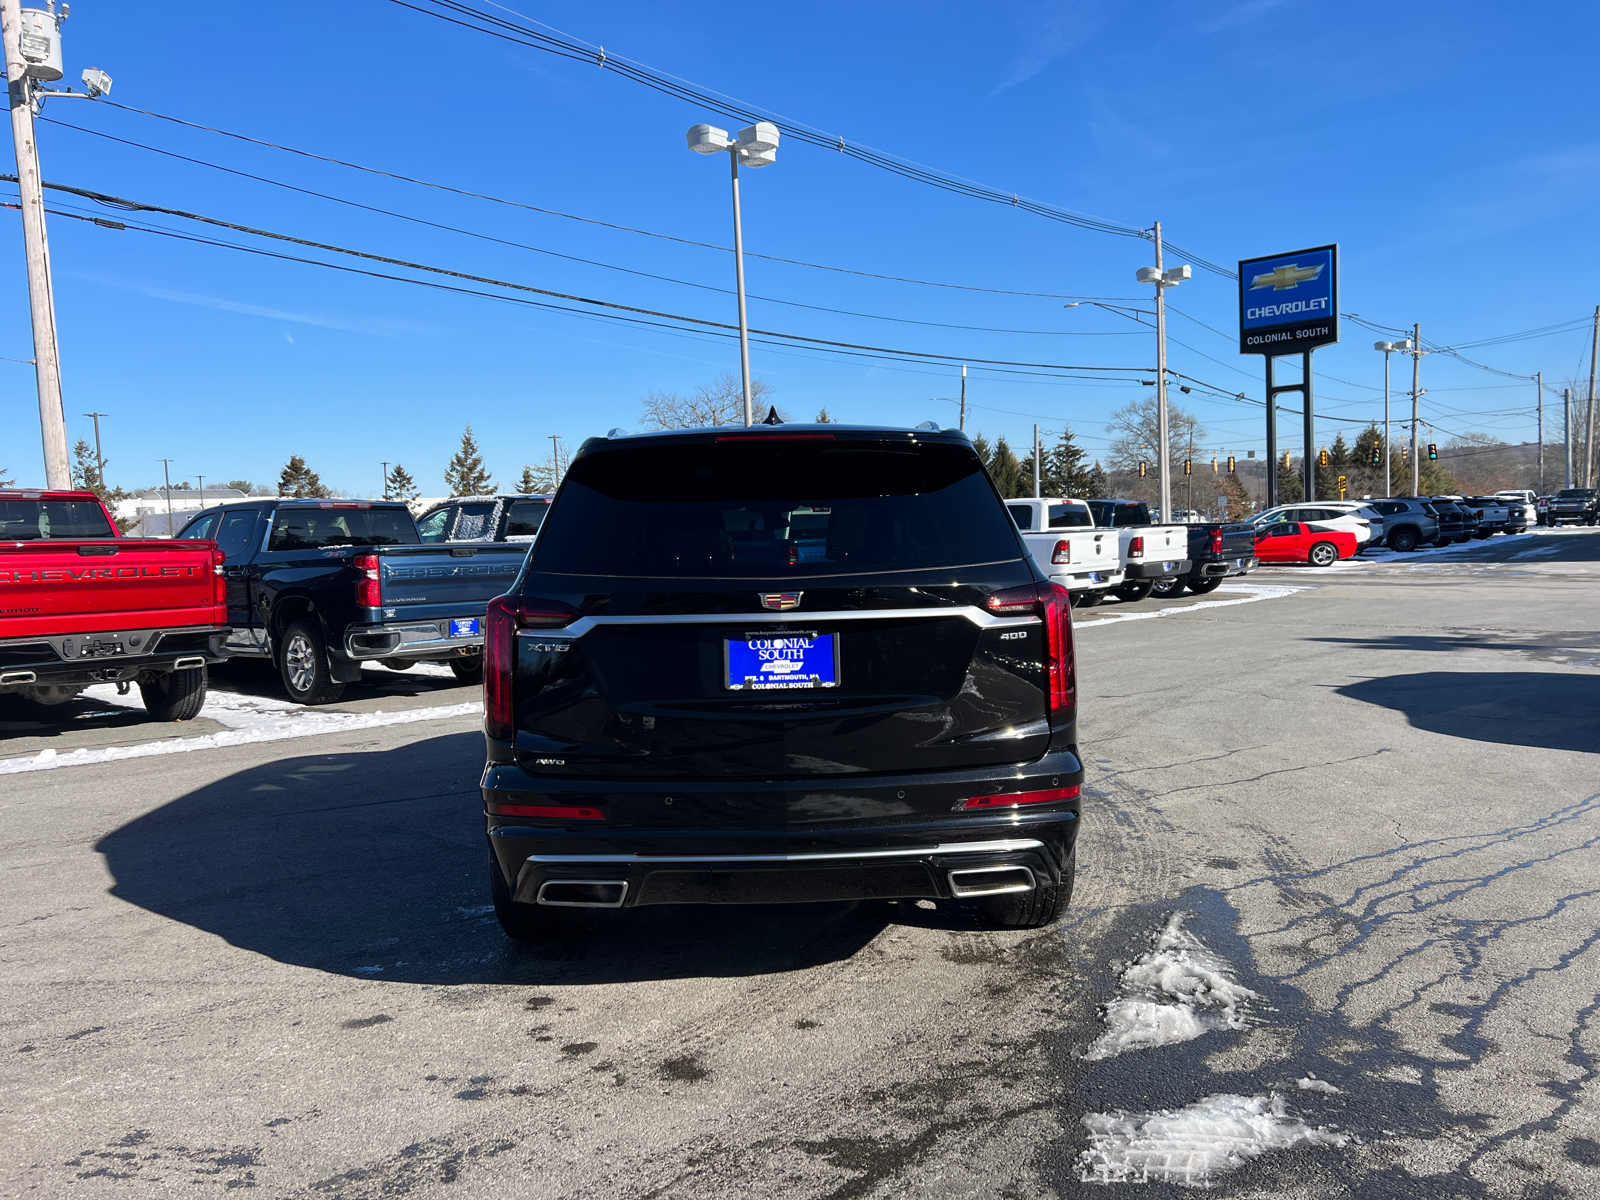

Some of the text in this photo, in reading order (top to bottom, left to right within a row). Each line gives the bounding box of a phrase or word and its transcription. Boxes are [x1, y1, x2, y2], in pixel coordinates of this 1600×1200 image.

[1247, 297, 1328, 319] CHEVROLET
[1247, 326, 1329, 345] COLONIAL SOUTH
[394, 565, 522, 578] CHEVROLE
[1000, 631, 1028, 640] 400
[527, 643, 570, 652] XT6
[748, 638, 814, 649] COLONIAL
[758, 649, 804, 660] SOUTH
[751, 681, 814, 690] COLONIAL SOUTH
